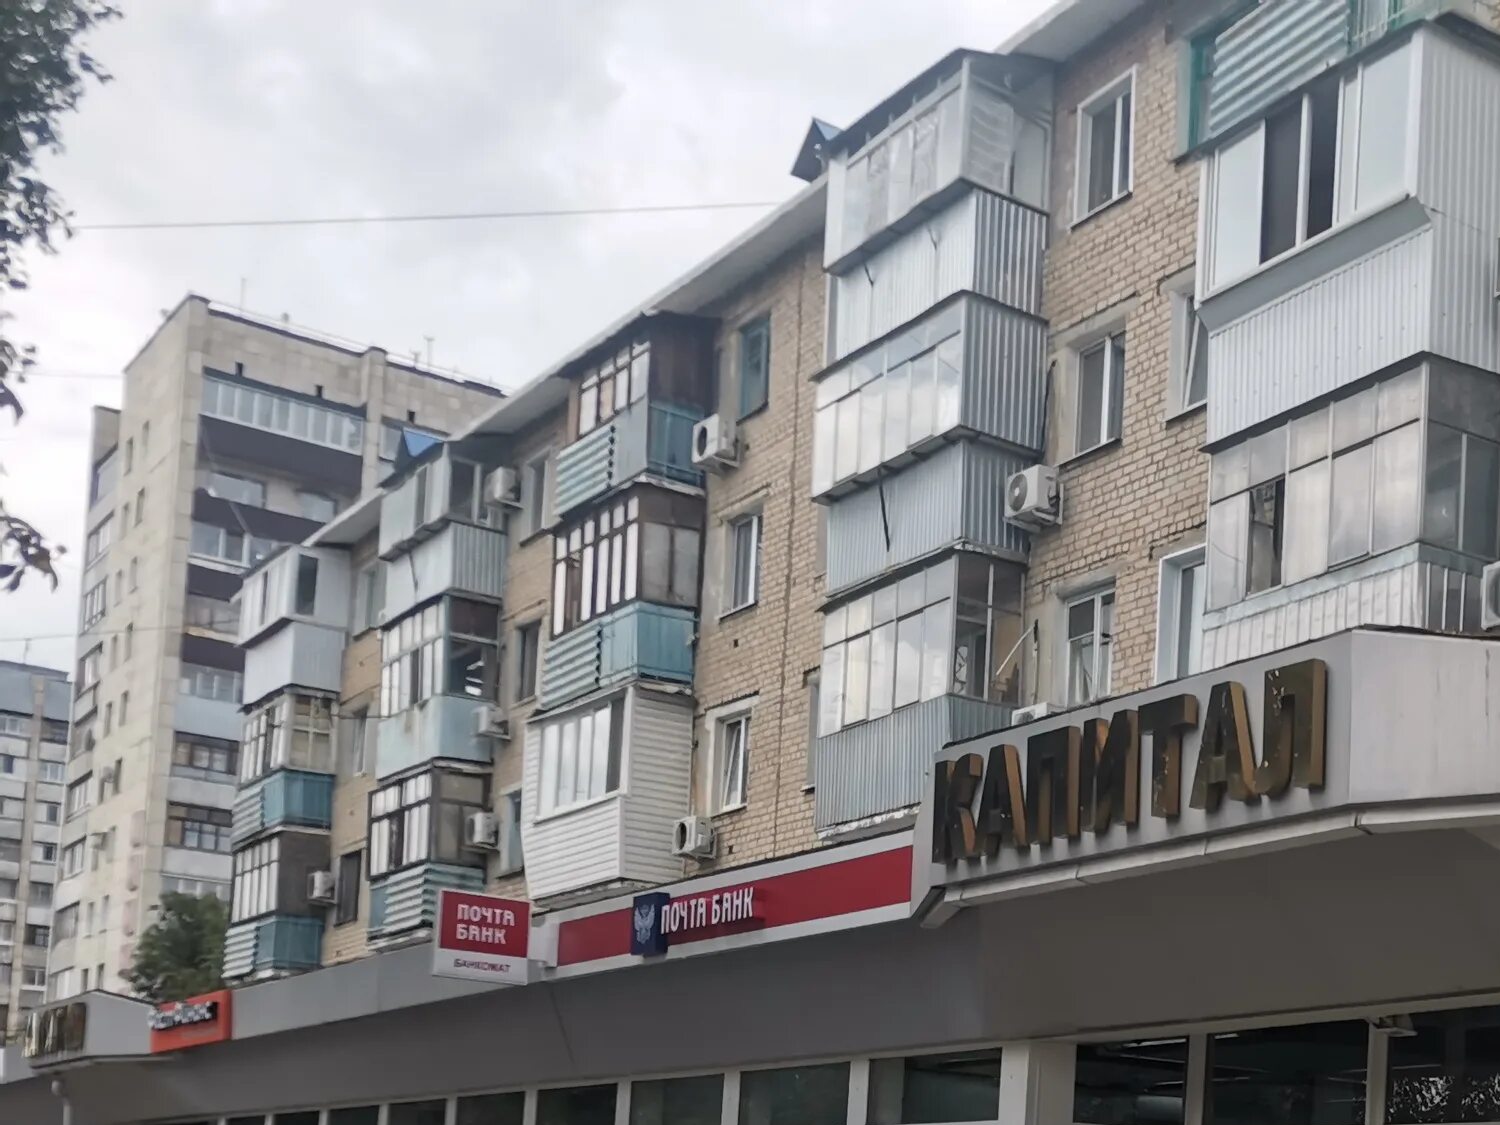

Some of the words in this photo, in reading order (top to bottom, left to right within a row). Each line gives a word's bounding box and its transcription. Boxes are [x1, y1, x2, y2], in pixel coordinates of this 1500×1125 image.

[932, 658, 1327, 864] КАПИТАЛ
[457, 903, 515, 926] ПОЧТА
[660, 897, 706, 934] ПОЧТА
[711, 886, 754, 924] БАНК
[455, 923, 507, 945] БАНК
